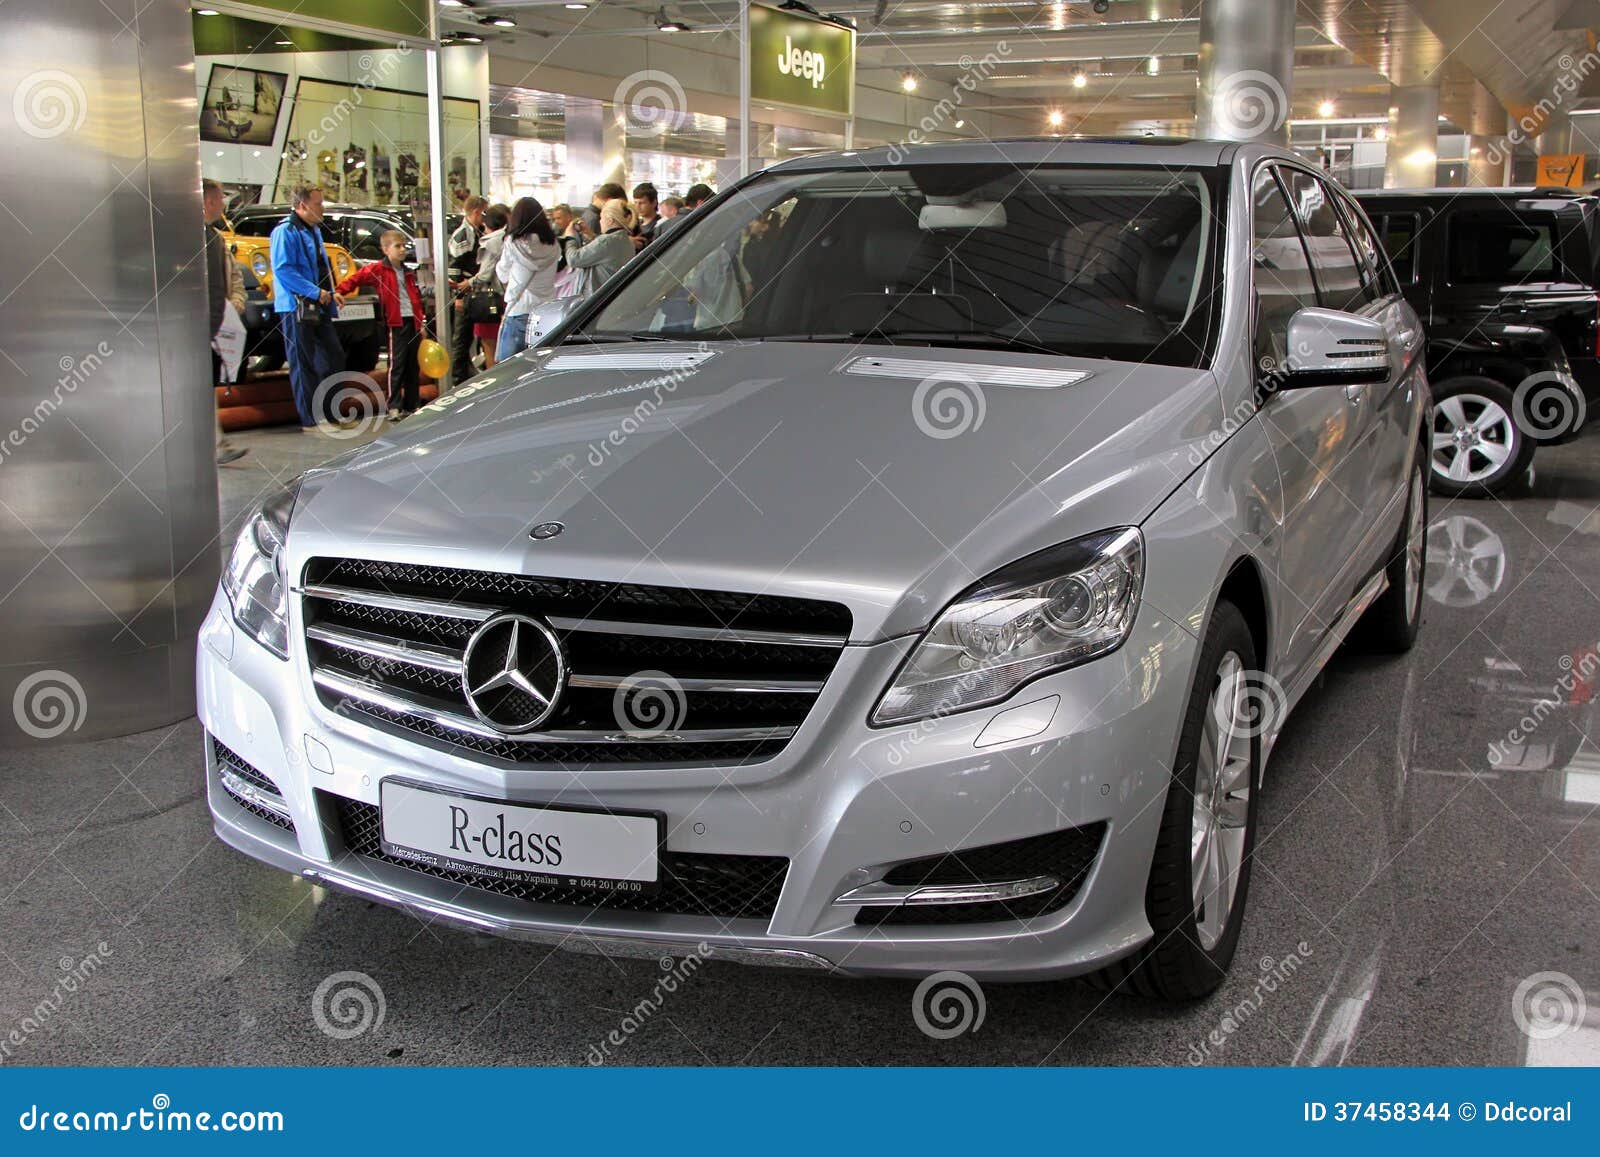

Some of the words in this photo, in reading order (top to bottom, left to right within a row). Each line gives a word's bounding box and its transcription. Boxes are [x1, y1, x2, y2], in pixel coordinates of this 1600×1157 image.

[777, 34, 826, 89] Jeep
[449, 805, 563, 866] R-class
[580, 878, 597, 889] 044
[599, 880, 614, 890] 201
[616, 880, 629, 891] 60
[630, 882, 642, 892] 00
